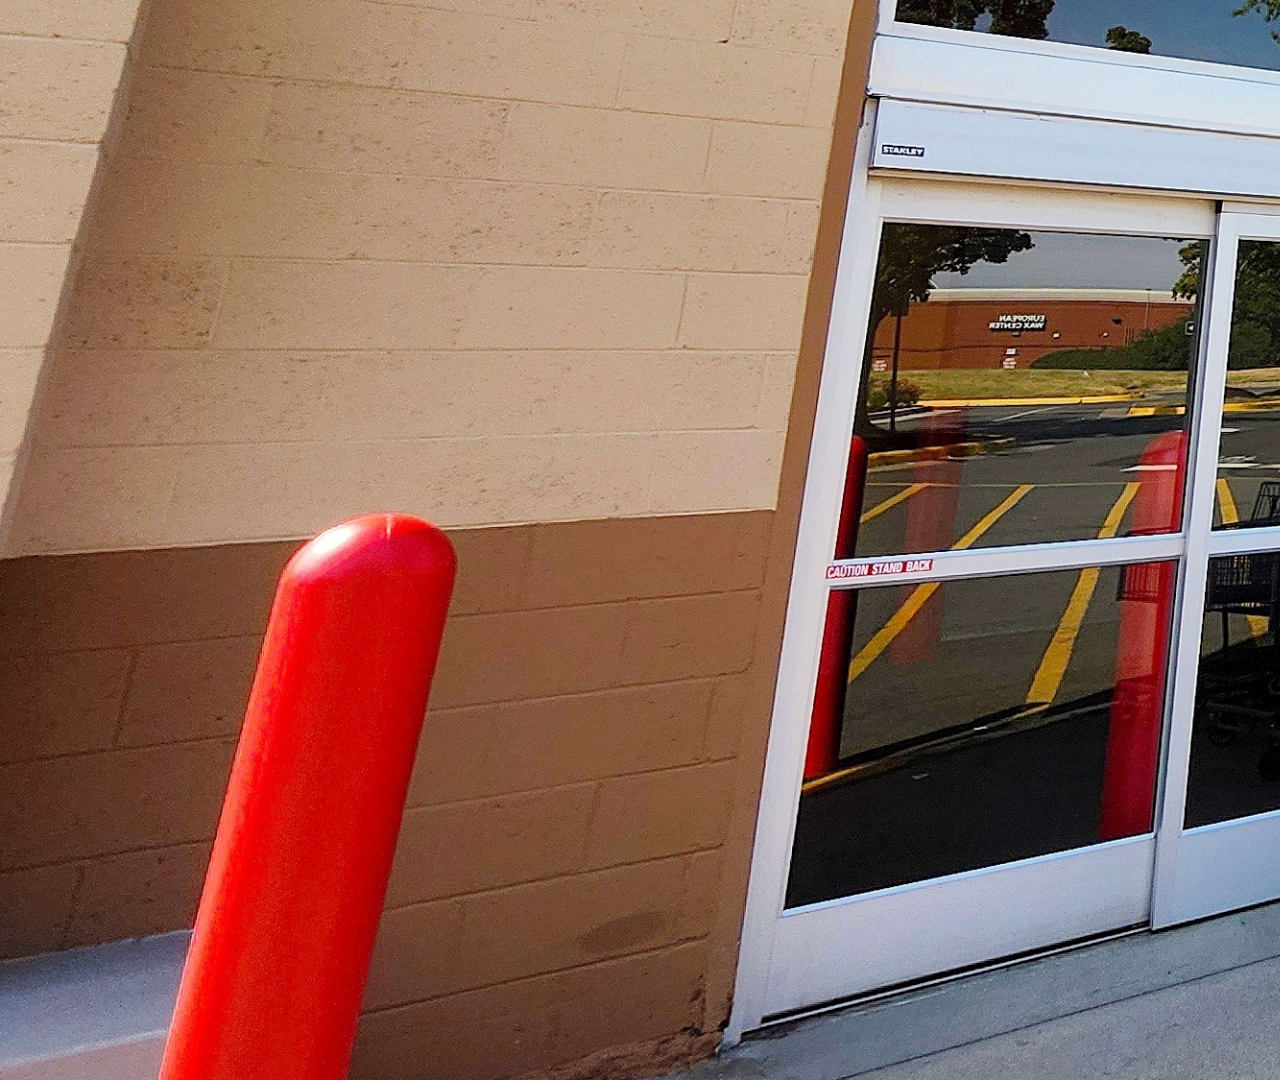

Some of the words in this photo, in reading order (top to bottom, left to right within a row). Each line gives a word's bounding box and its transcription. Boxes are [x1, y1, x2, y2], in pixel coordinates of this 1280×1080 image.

[882, 146, 924, 156] STANLEY
[827, 565, 868, 579] CAUTION
[872, 561, 902, 575] STAND
[906, 559, 931, 572] BACK
